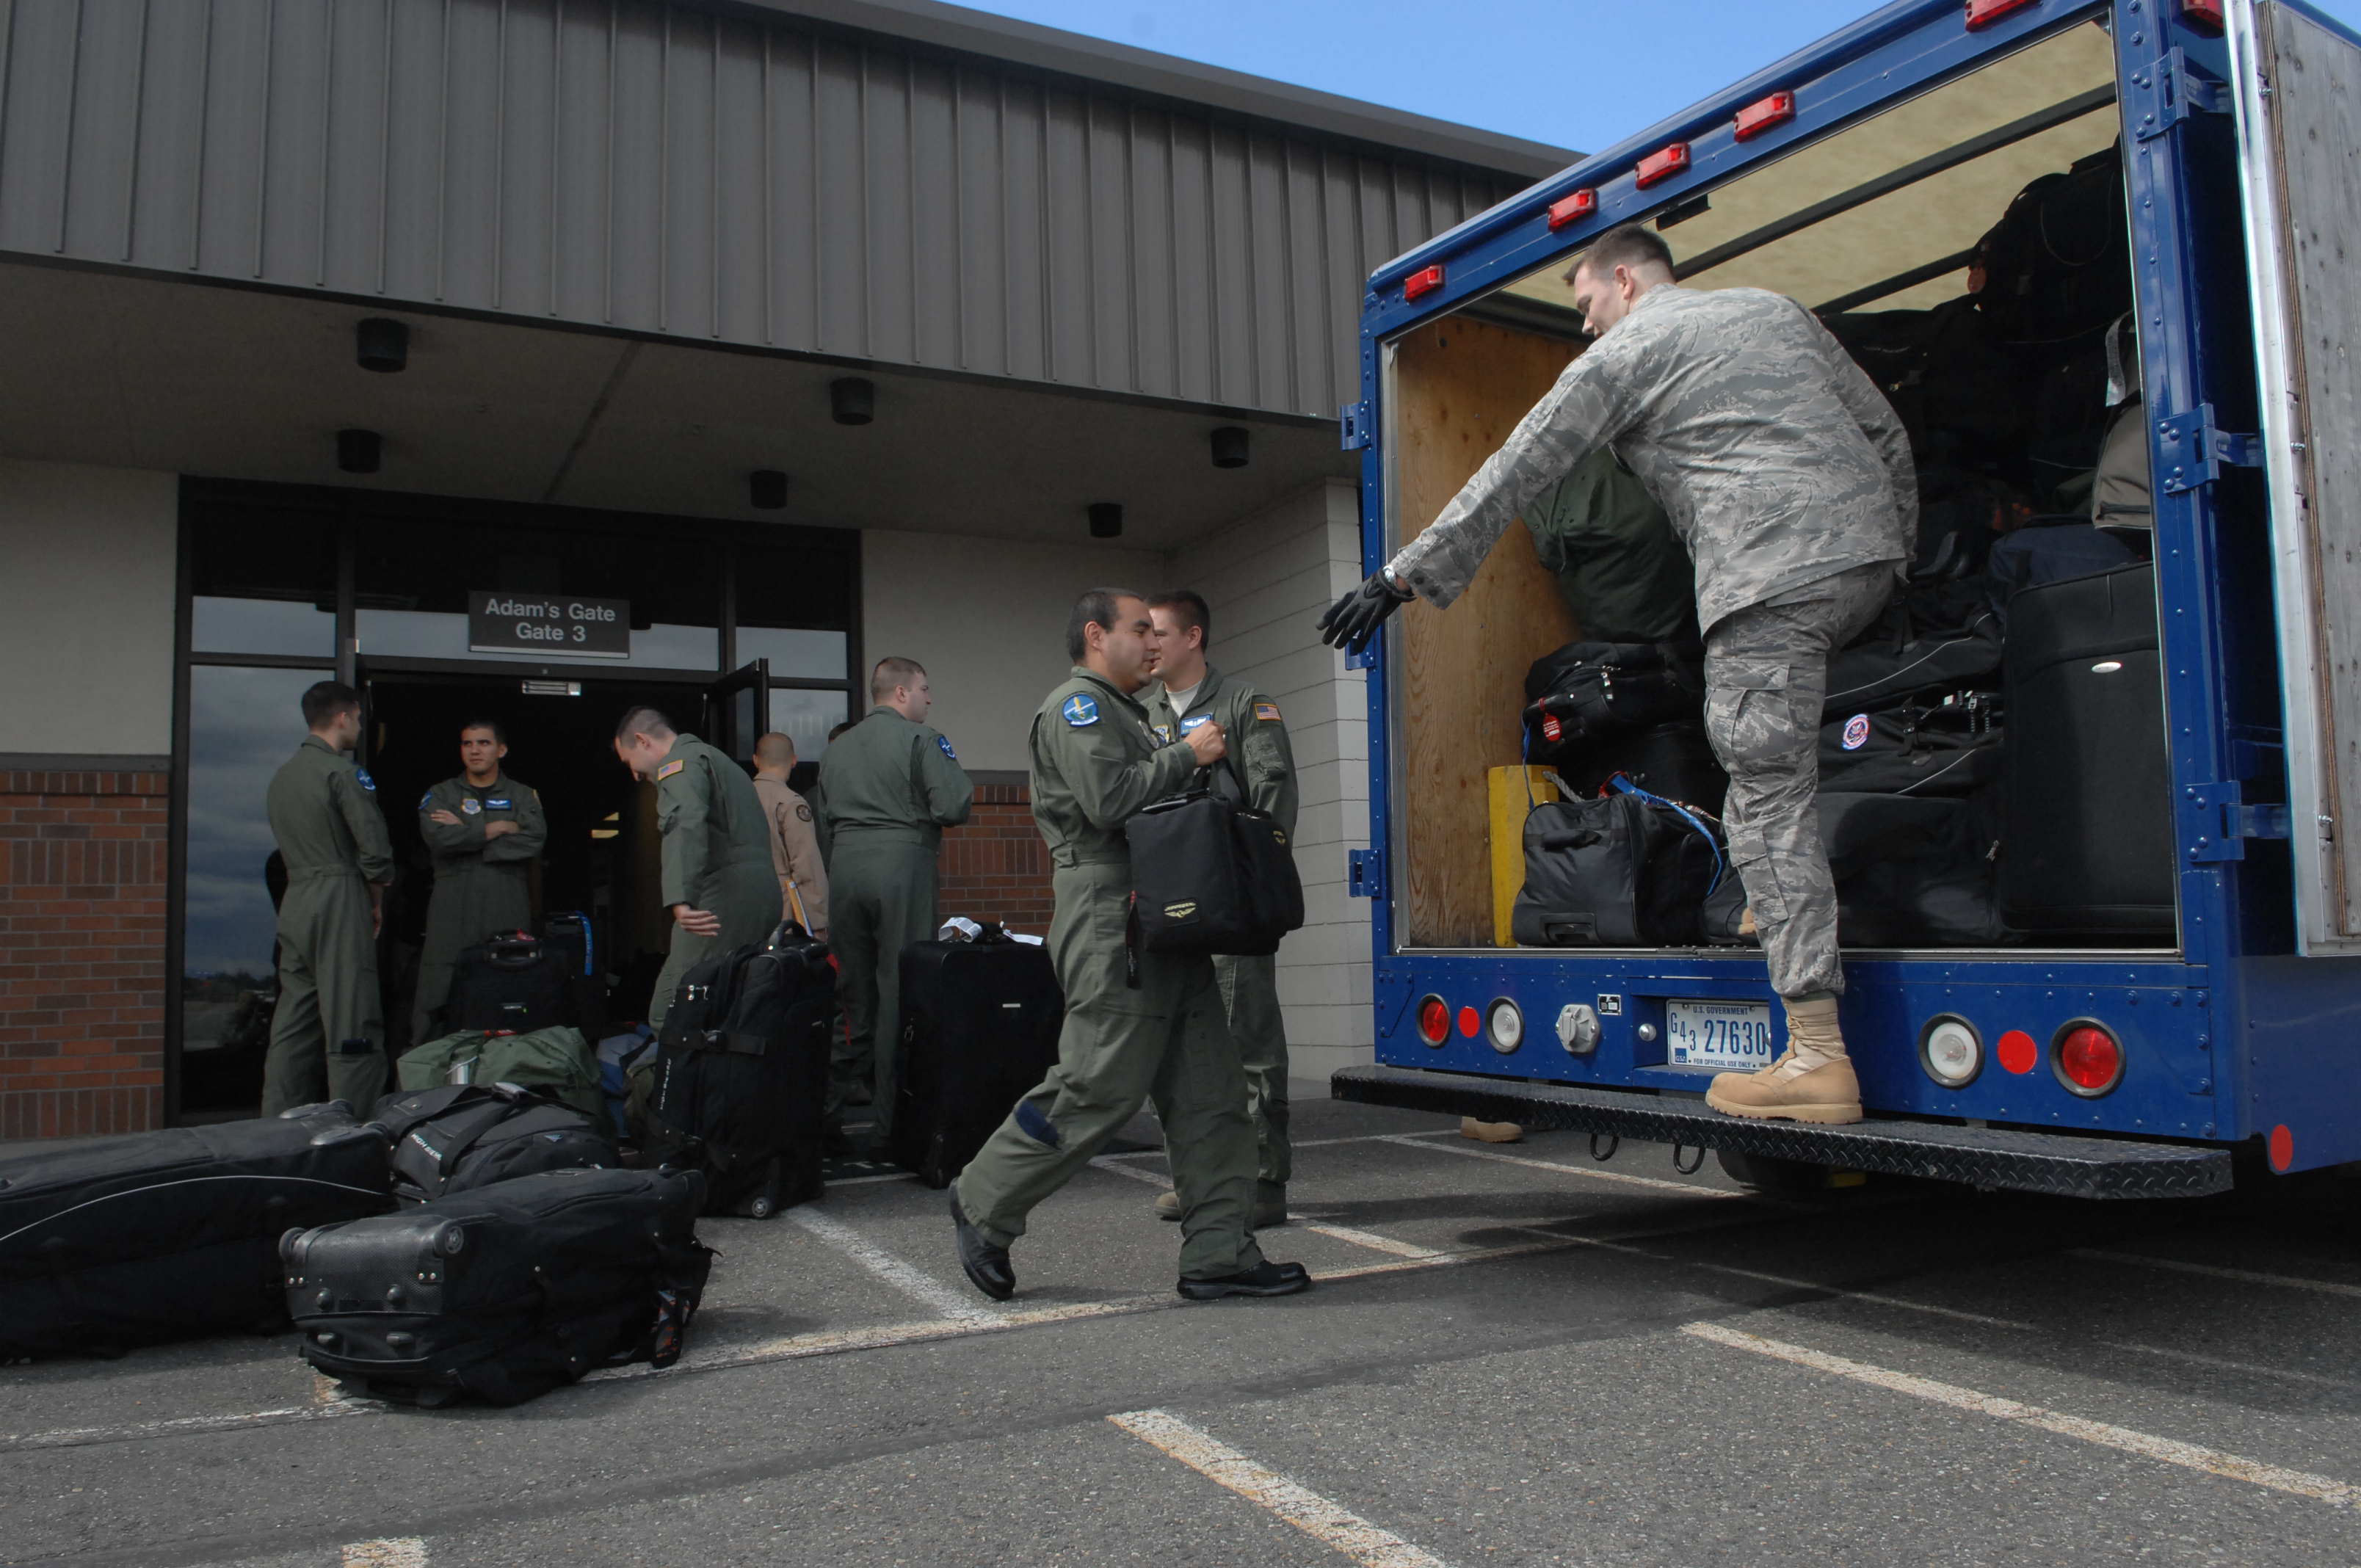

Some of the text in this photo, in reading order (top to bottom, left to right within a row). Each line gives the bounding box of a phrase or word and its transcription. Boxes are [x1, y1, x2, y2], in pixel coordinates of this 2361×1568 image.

[485, 598, 616, 622] Adam's Gate
[515, 622, 586, 642] Gate 3
[1693, 1006, 1748, 1015] U.S. GOVERNMENT
[1704, 1020, 1766, 1056] 27630
[1705, 1059, 1726, 1067] OFFICIAL
[411, 1133, 428, 1147] HIGH
